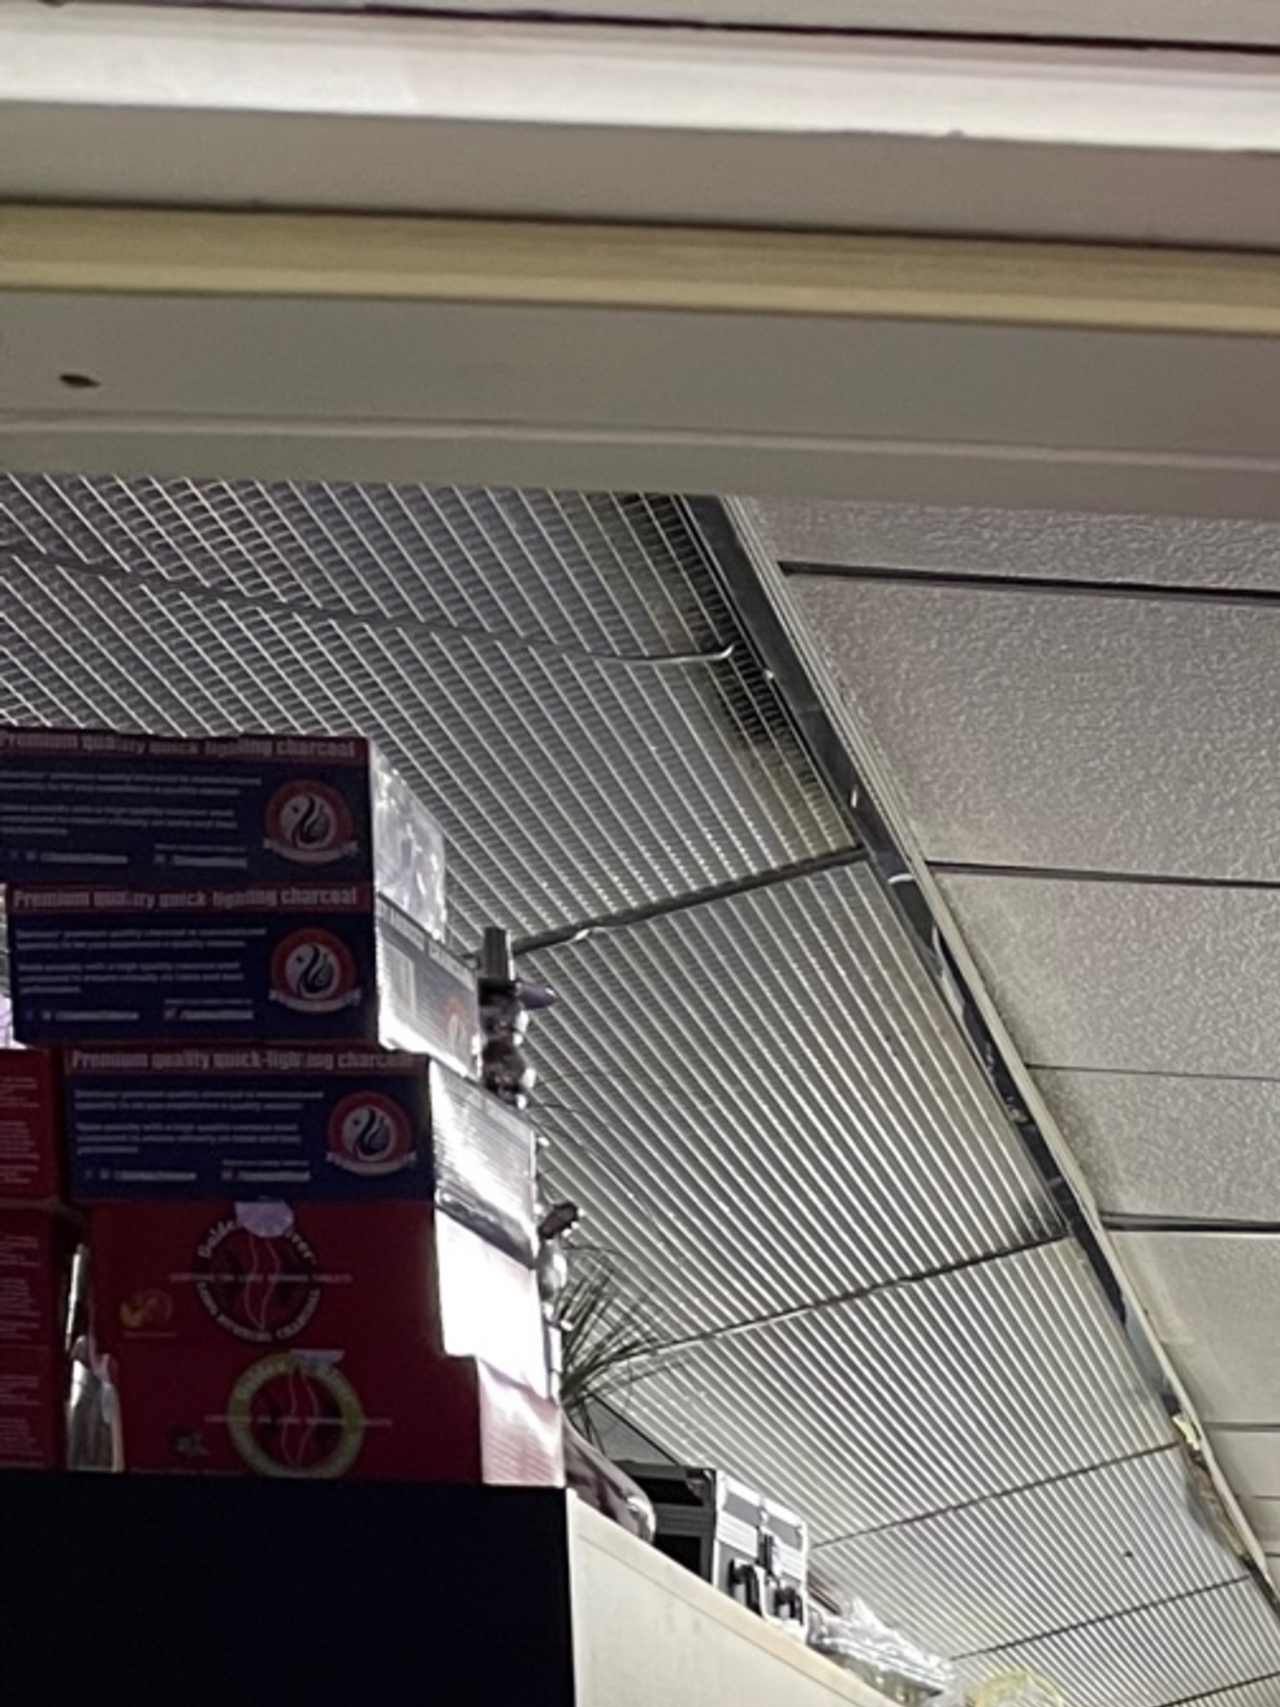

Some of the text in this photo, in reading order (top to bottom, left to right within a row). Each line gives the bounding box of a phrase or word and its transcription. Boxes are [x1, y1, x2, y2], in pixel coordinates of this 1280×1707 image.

[14, 889, 91, 908] Premium
[281, 886, 357, 906] charcoal
[73, 1050, 148, 1069] Premium
[151, 1050, 210, 1071] quality
